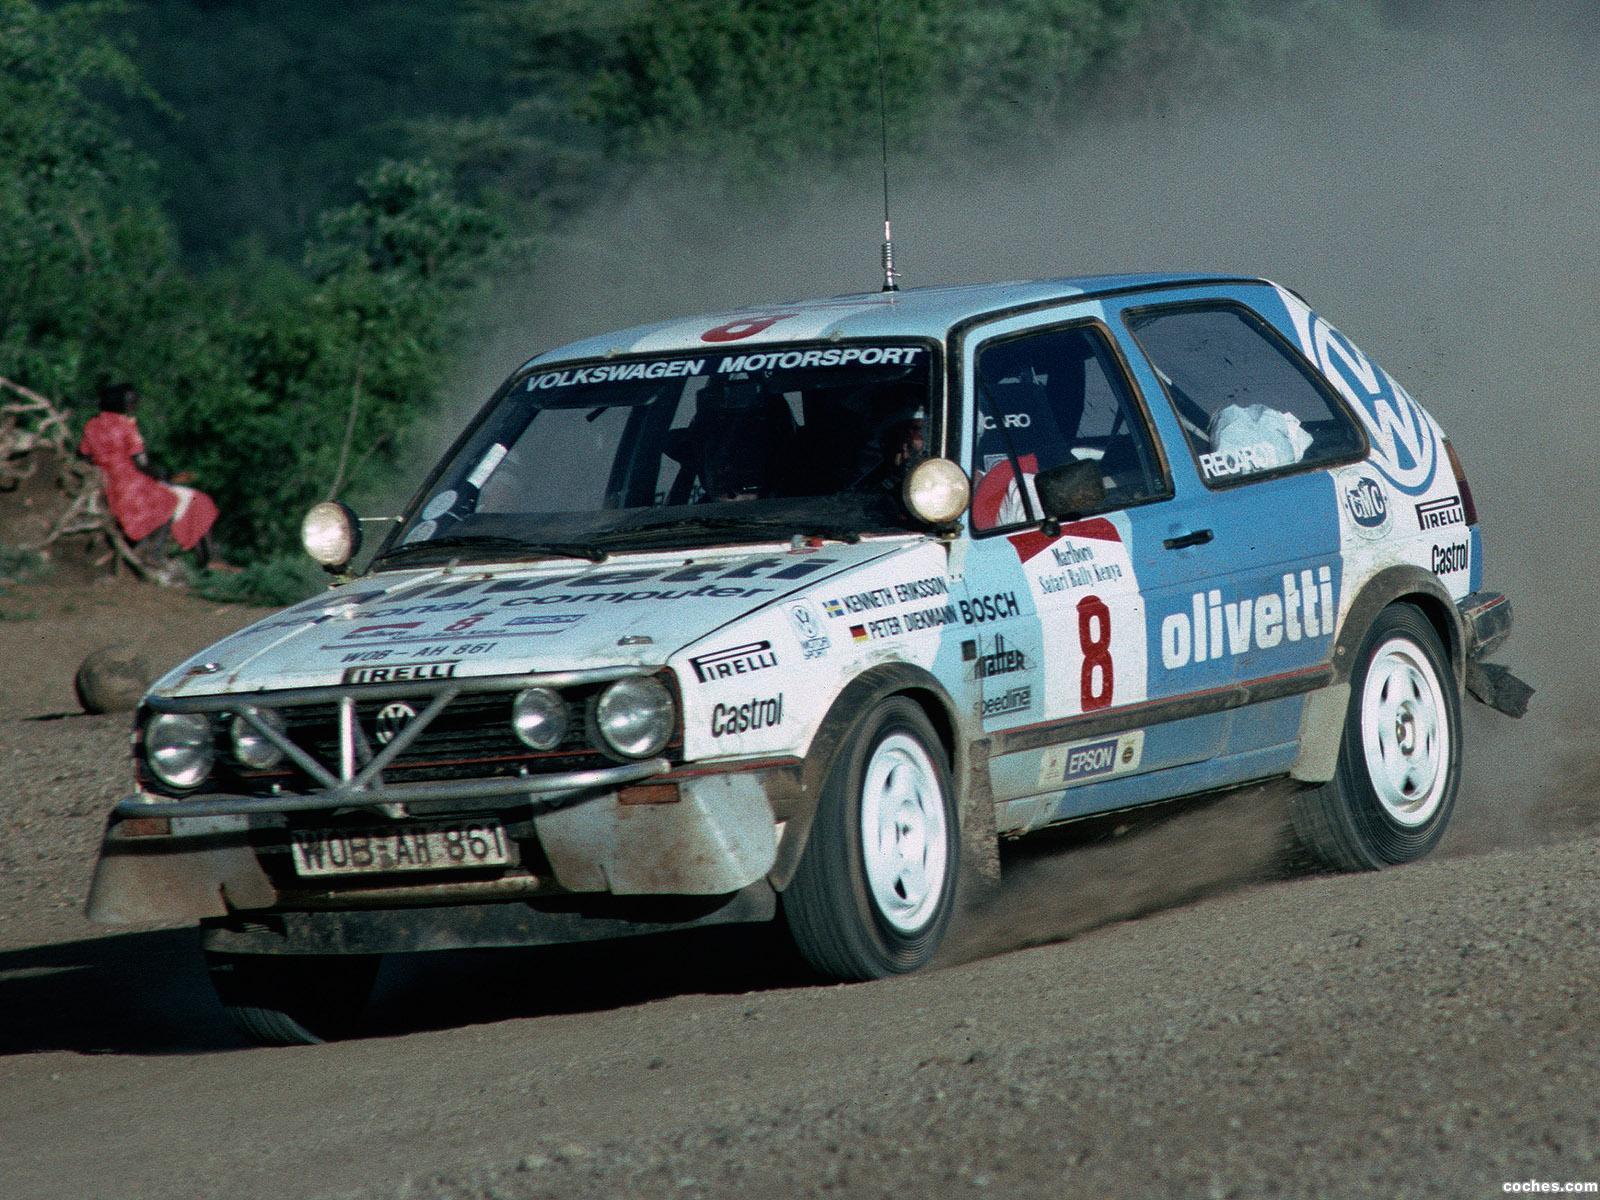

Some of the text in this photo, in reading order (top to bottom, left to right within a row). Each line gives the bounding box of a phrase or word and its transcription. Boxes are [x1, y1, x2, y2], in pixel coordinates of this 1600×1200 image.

[526, 346, 922, 392] VOLKSWAGEN MOTORSPORT
[1415, 495, 1464, 531] PIRELLI
[1052, 541, 1095, 567] Marlboro
[1431, 539, 1469, 575] Castrol
[500, 584, 775, 606] computer
[842, 575, 950, 613] KENNETH ERIKSSON
[1038, 563, 1123, 595] Safari Rally Kenya
[868, 604, 960, 640] PETER DIEKMANN
[959, 591, 1021, 625] BOSCH
[1161, 565, 1333, 670] olivetti
[412, 644, 450, 658] AH
[452, 642, 498, 656] 861
[688, 640, 778, 684] PIRELLI
[1076, 595, 1115, 712] 8
[341, 659, 462, 684] PIRELLI
[711, 692, 783, 738] Castrol
[1069, 746, 1114, 774] EPSON
[444, 824, 505, 860] 861
